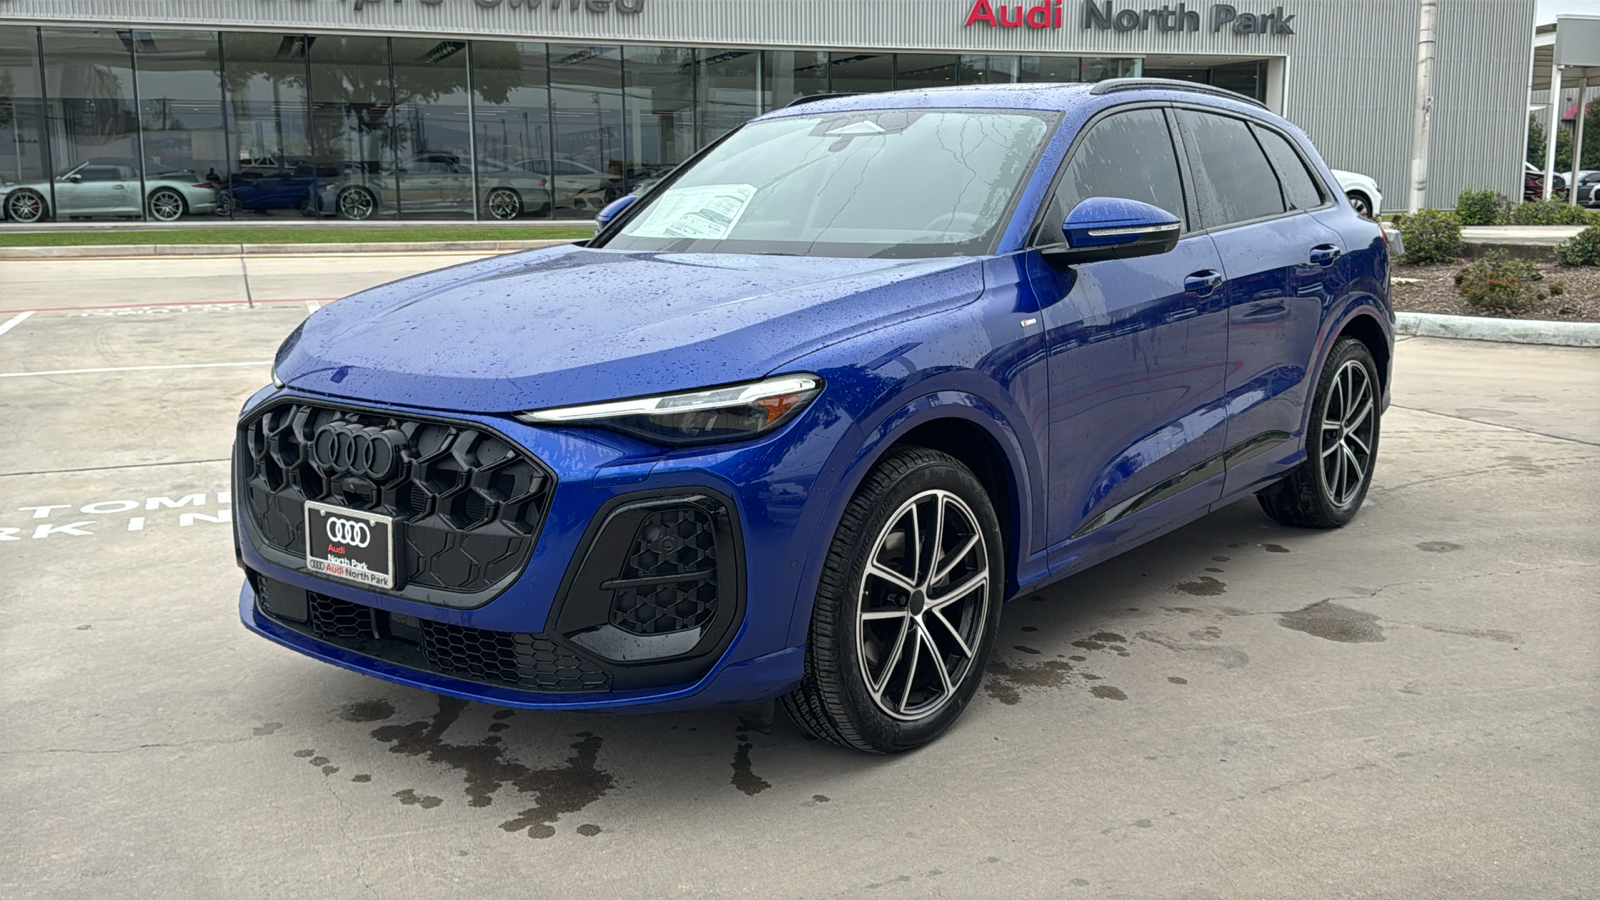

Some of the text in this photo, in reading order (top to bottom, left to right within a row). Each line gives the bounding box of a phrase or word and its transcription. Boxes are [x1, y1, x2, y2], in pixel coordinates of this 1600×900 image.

[964, 0, 1295, 35] Audi North Park
[328, 544, 345, 554] Audi
[328, 554, 368, 569] North Park
[326, 564, 388, 586] Audi North Park
